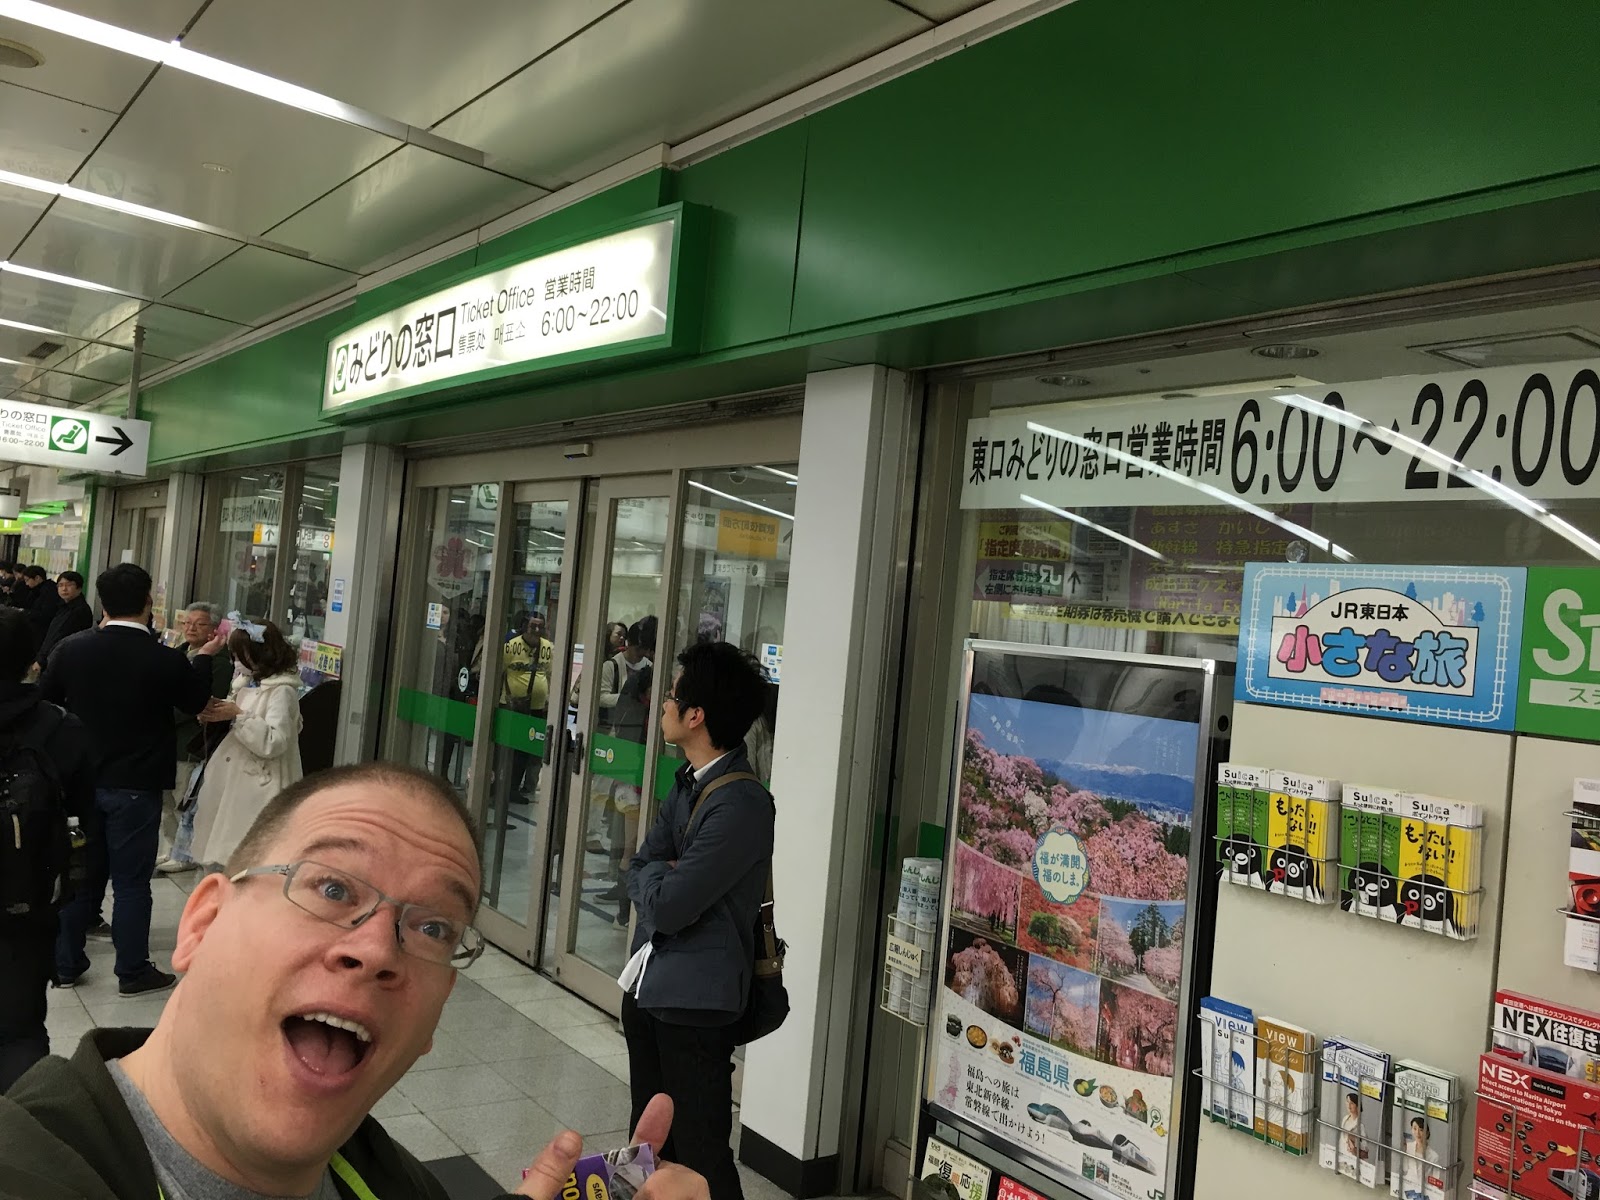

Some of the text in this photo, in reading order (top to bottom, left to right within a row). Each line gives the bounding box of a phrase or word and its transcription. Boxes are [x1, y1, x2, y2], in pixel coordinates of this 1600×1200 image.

[544, 266, 596, 300] 営業時間
[461, 287, 535, 325] Ticket Office
[349, 306, 457, 384] みどりの窓口
[969, 418, 1225, 486] 東口みどりの窓口営業時間
[1330, 602, 1409, 621] JR東日本
[1276, 624, 1469, 689] 小さな旅
[1282, 776, 1314, 791] Suica
[1412, 800, 1450, 816] Suica
[1217, 1029, 1245, 1045] Suca
[967, 1063, 1020, 1099] 福島への旅は
[1018, 1048, 1070, 1092] 福島県
[1481, 1076, 1567, 1110] Direct access to Narita Airport
[1481, 1083, 1563, 1117] from major stations in Tokyo
[1537, 1111, 1555, 1123] areas
[1555, 1117, 1565, 1125] on
[1564, 1119, 1577, 1129] the
